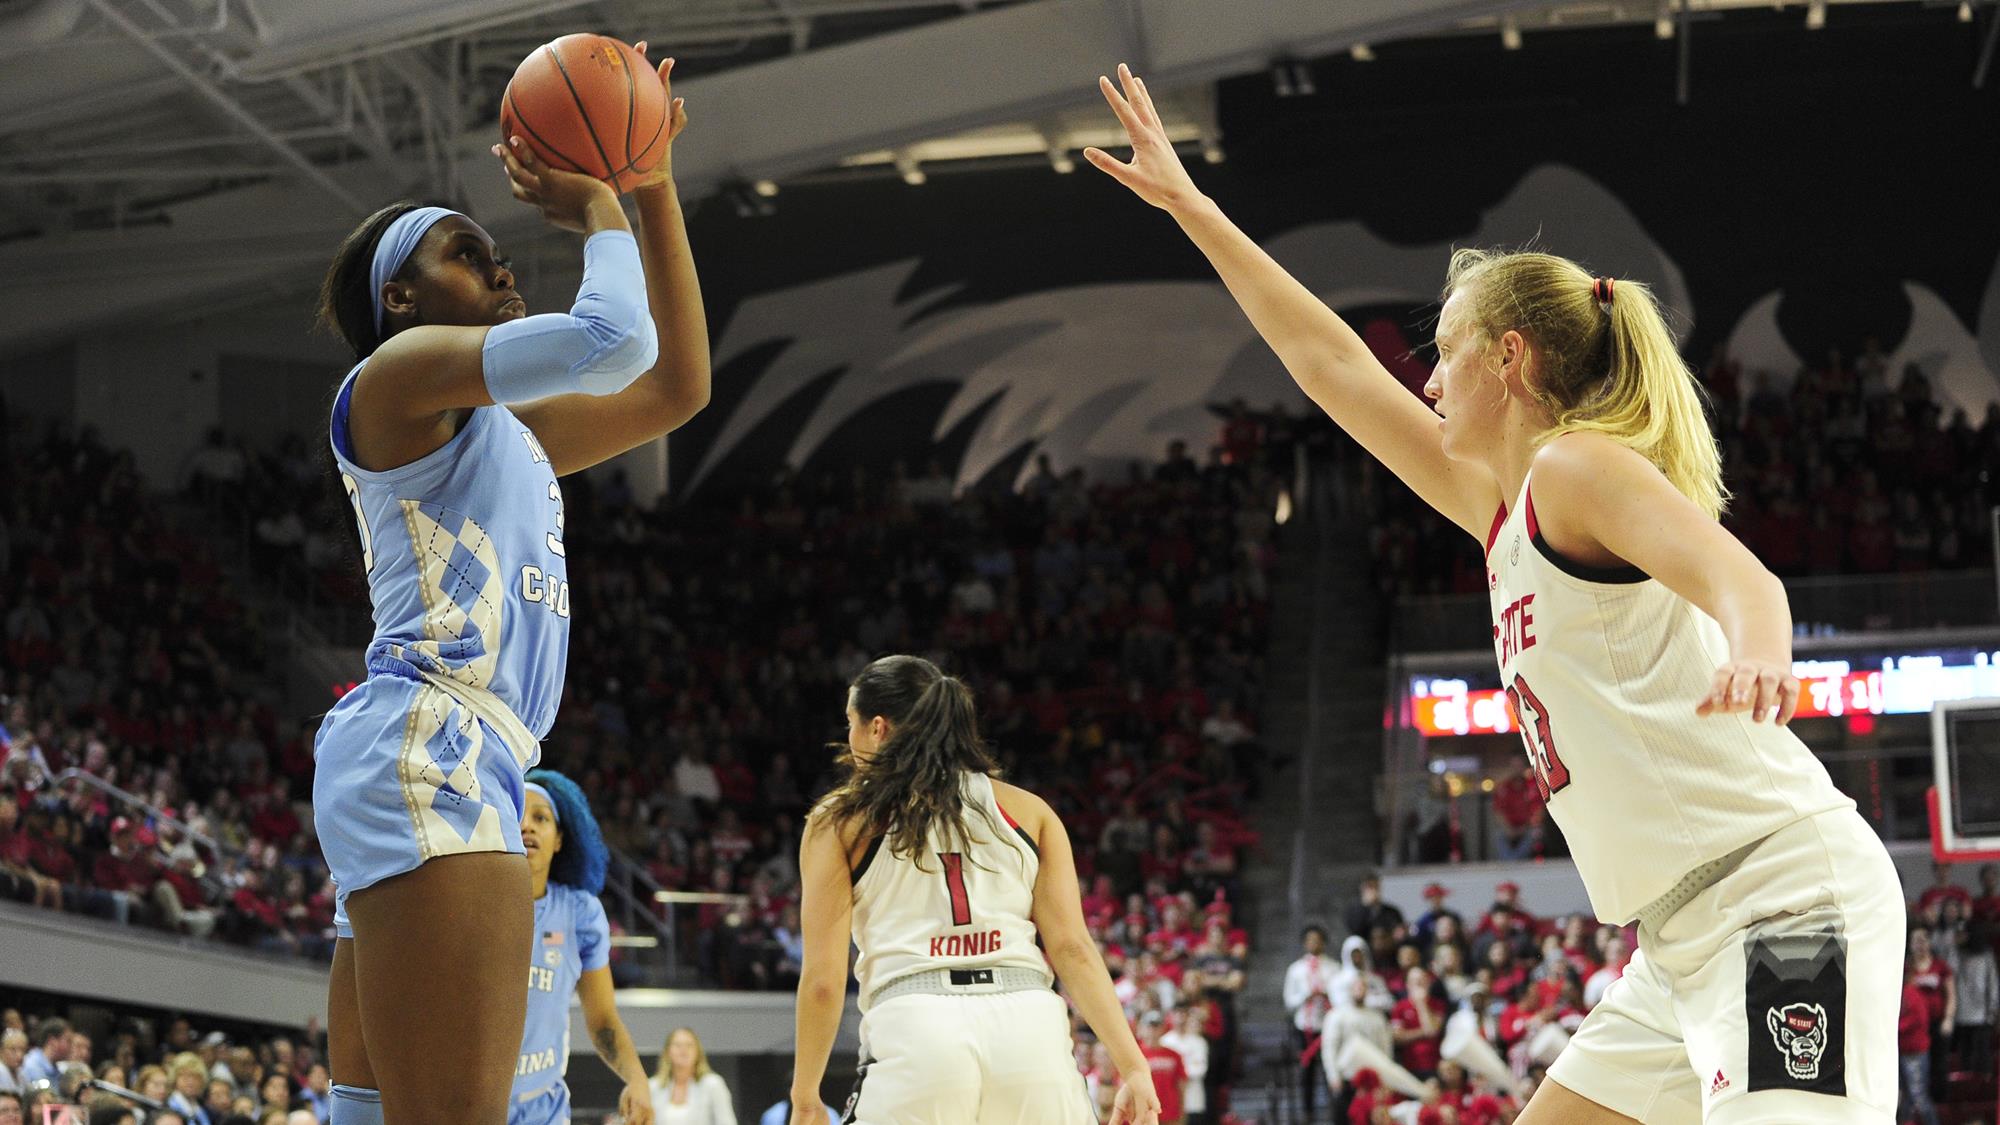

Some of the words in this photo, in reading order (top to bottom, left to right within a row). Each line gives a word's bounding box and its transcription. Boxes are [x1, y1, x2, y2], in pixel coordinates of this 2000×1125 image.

[936, 852, 973, 927] 1
[929, 929, 1002, 957] KONIG
[514, 1047, 556, 1077] INA
